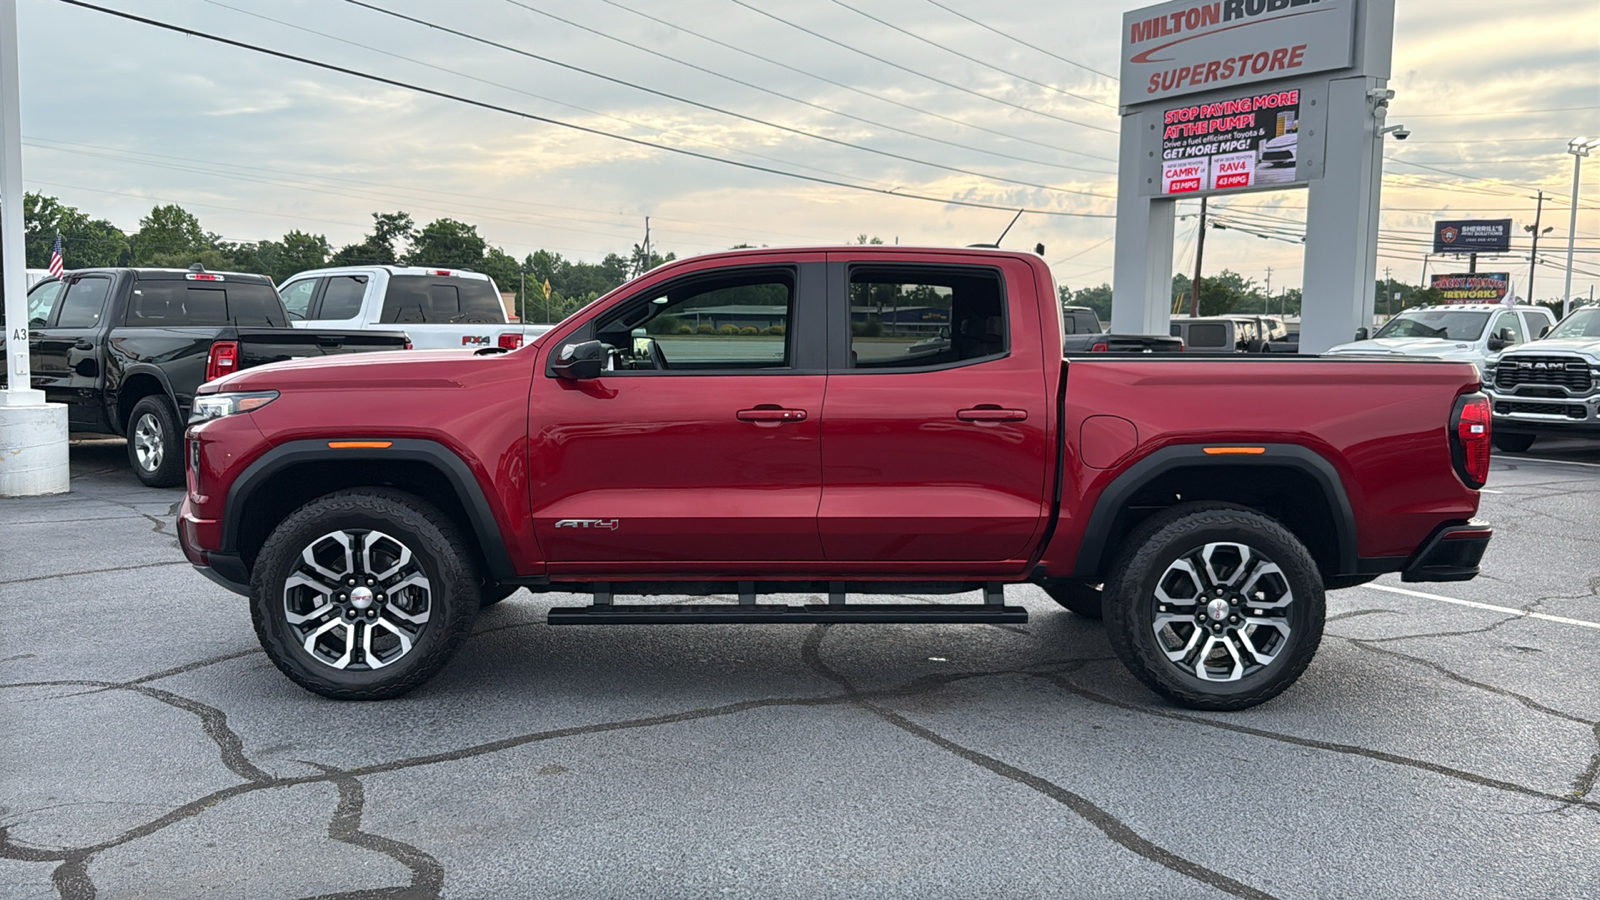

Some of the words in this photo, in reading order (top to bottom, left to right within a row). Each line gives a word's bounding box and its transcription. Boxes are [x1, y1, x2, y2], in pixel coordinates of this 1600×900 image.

[1130, 3, 1220, 44] MILTON
[1223, 0, 1320, 22] RUB
[1147, 44, 1307, 94] SUPERSTORE
[1165, 106, 1199, 124] STOP
[1200, 99, 1251, 119] PAYING
[1253, 90, 1299, 110] MORE
[1163, 123, 1180, 139] AT
[1180, 121, 1208, 137] THE
[1209, 114, 1255, 132] PUMP!
[1188, 136, 1201, 145] fuel
[1202, 133, 1232, 143] efficient
[1233, 129, 1257, 140] Toyota
[1258, 128, 1265, 136] &
[1163, 149, 1184, 160] GET
[1185, 144, 1218, 157] MORE
[1219, 139, 1250, 153] MPG!
[1165, 166, 1200, 178] CAMRY
[1219, 161, 1246, 173] RAV4
[1181, 180, 1198, 189] MPG
[1228, 175, 1246, 184] MPG
[1433, 278, 1466, 288] WACKY
[1441, 290, 1497, 299] IREWORKS
[13, 329, 27, 340] A3
[462, 336, 490, 346] FX4
[1518, 361, 1563, 370] RAM
[554, 519, 619, 531] AT4
